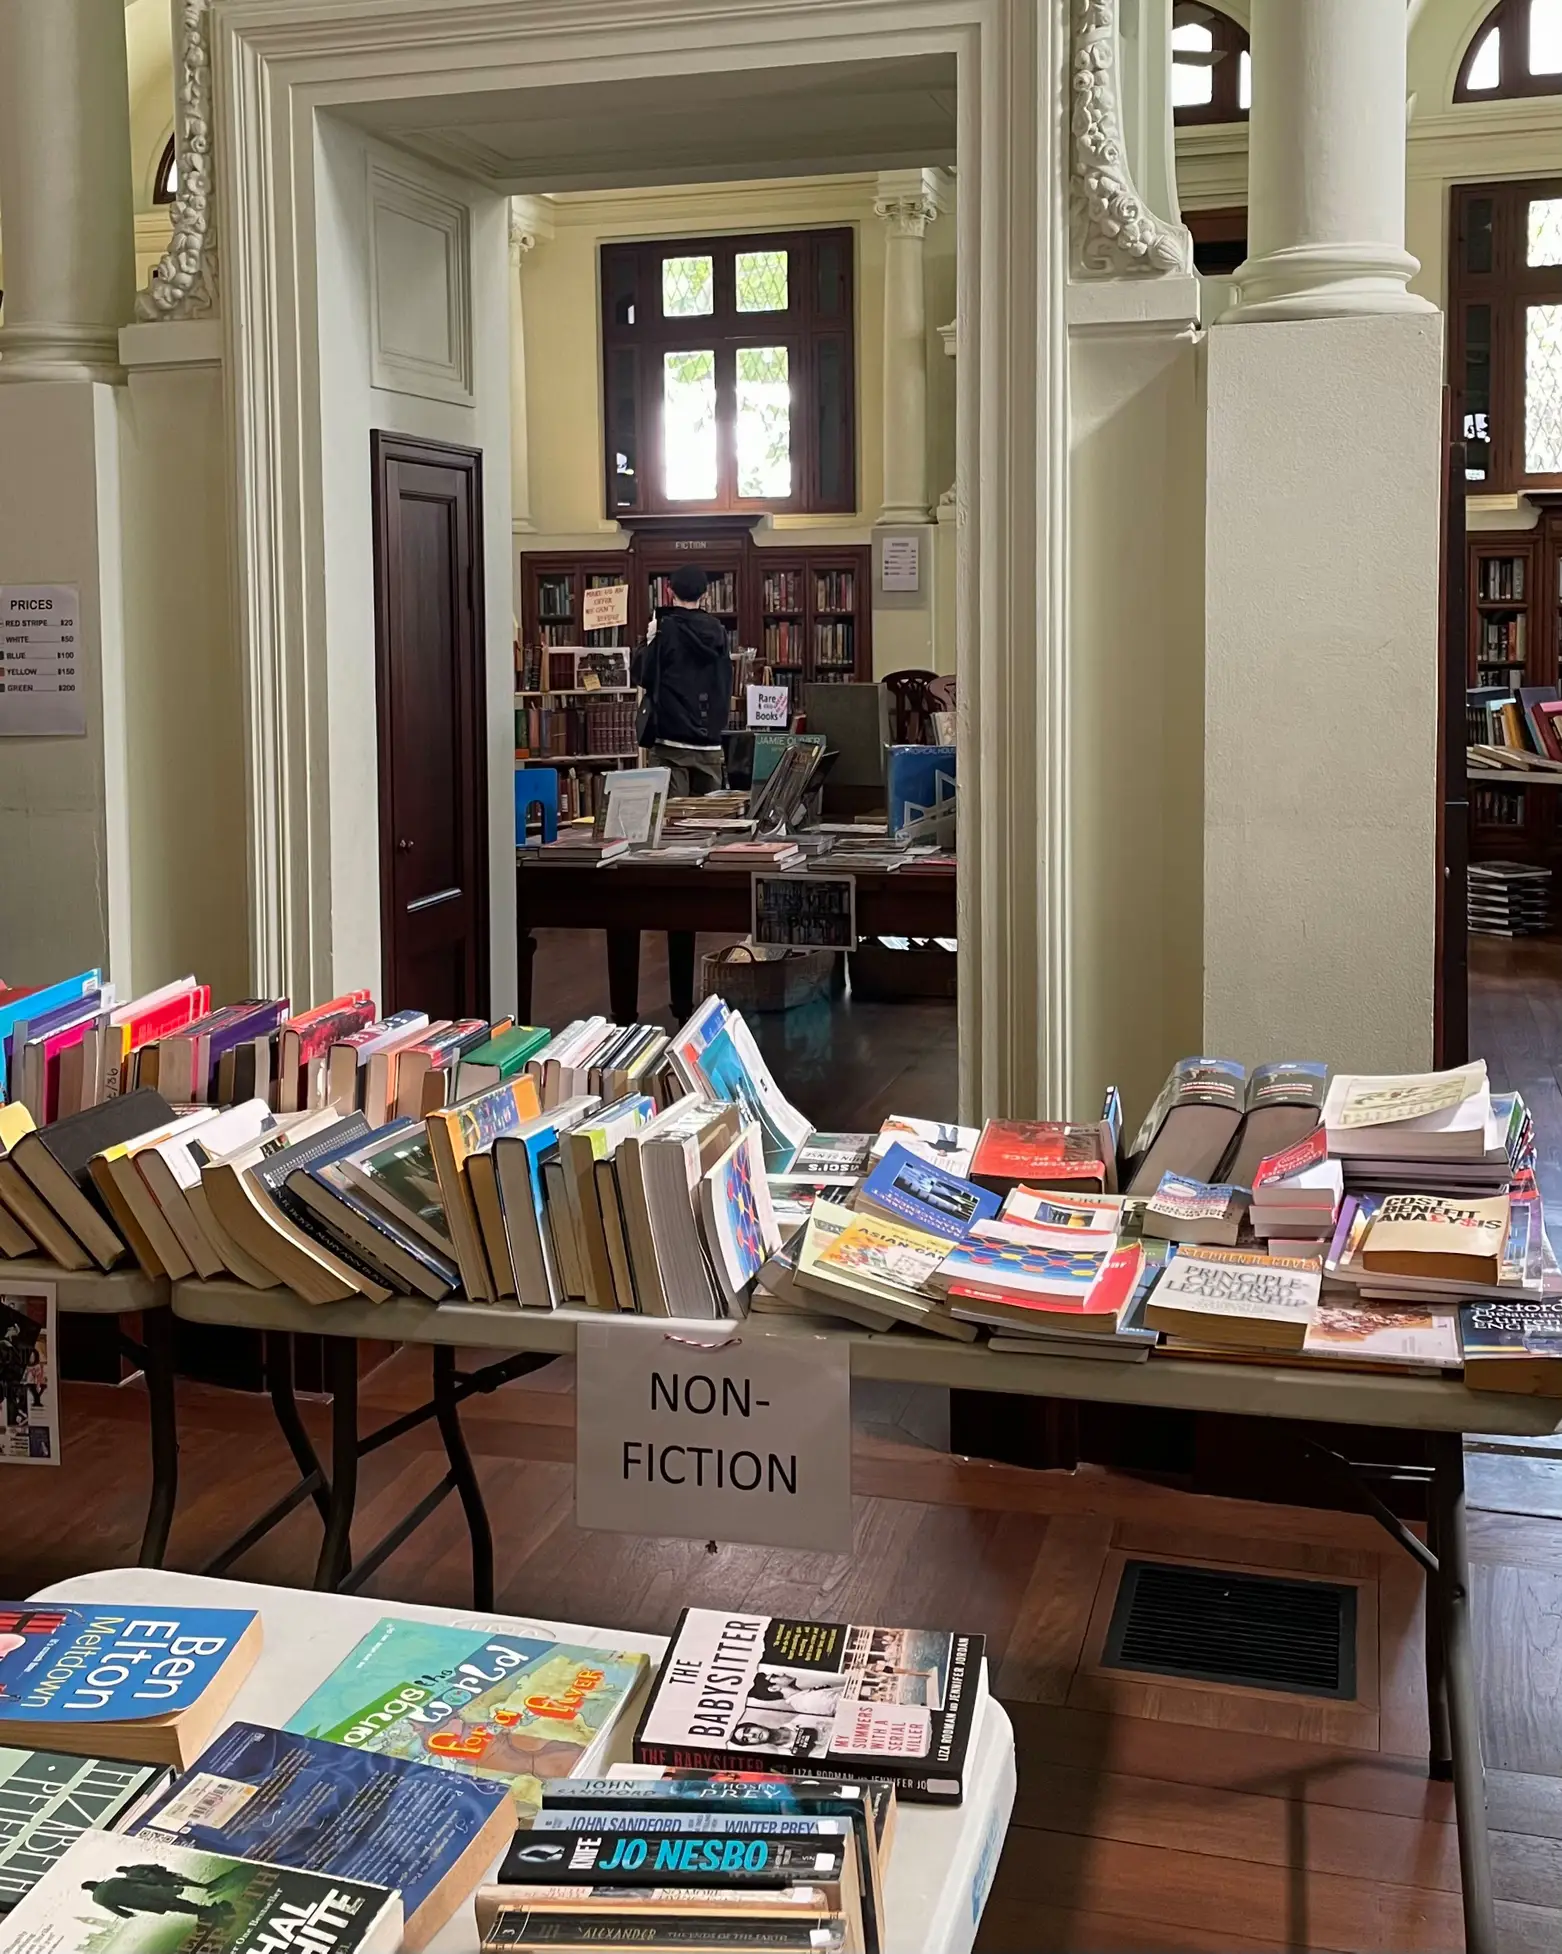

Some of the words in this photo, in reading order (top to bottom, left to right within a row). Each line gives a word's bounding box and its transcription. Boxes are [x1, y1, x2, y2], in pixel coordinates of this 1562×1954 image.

[10, 600, 53, 610] PRICES
[6, 652, 26, 660] BLUE
[758, 693, 776, 703] Rare
[755, 711, 778, 721] Books
[757, 736, 785, 745] JAMIE
[1382, 1205, 1480, 1219] BENEFIT
[1385, 1197, 1453, 1207] COST-
[858, 1227, 909, 1249] ASIAN
[1183, 1248, 1246, 1266] STEPHEN
[1271, 1257, 1321, 1273] COVEY
[1184, 1265, 1311, 1289] PRINCIPLE-
[1186, 1276, 1294, 1298] CENTRED
[1165, 1280, 1310, 1308] LEADERSHIP
[1472, 1309, 1556, 1319] Thesaurus
[651, 1372, 770, 1418] NON-
[623, 1441, 797, 1494] FICTION
[954, 1637, 970, 1665] JORDAN
[20, 1616, 126, 1709] Meltdown
[63, 1619, 181, 1710] Elton
[133, 1635, 227, 1699] Ben
[669, 1659, 702, 1685] THE
[415, 1668, 453, 1687] the
[688, 1620, 761, 1737] BABYSITTER
[948, 1666, 965, 1702] JENNIFER
[494, 1709, 520, 1726] a
[852, 1707, 873, 1749] SUMMERS
[940, 1712, 957, 1744] RODMAN
[835, 1735, 849, 1748] MY
[870, 1728, 887, 1749] WITH
[888, 1722, 906, 1751] SERIAL
[906, 1723, 924, 1752] KILLER
[641, 1748, 667, 1765] THE
[673, 1751, 764, 1774] BABYSITTER
[936, 1745, 951, 1762] LIZA
[556, 1788, 657, 1798] SANDFORD
[585, 1780, 635, 1790] JOHN
[699, 1788, 781, 1800] PREY
[566, 1816, 605, 1831] JOHN
[608, 1818, 682, 1832] SANDFORD
[725, 1820, 777, 1833] WINTER
[781, 1822, 815, 1833] PREY
[568, 1837, 602, 1869] KNIFE
[599, 1839, 647, 1870] JO
[654, 1839, 769, 1871] NESBO
[235, 1927, 252, 1946] One
[248, 1887, 283, 1931] Bestseller
[582, 1928, 656, 1940] ALEXANDER
[756, 1934, 788, 1942] EARTH
